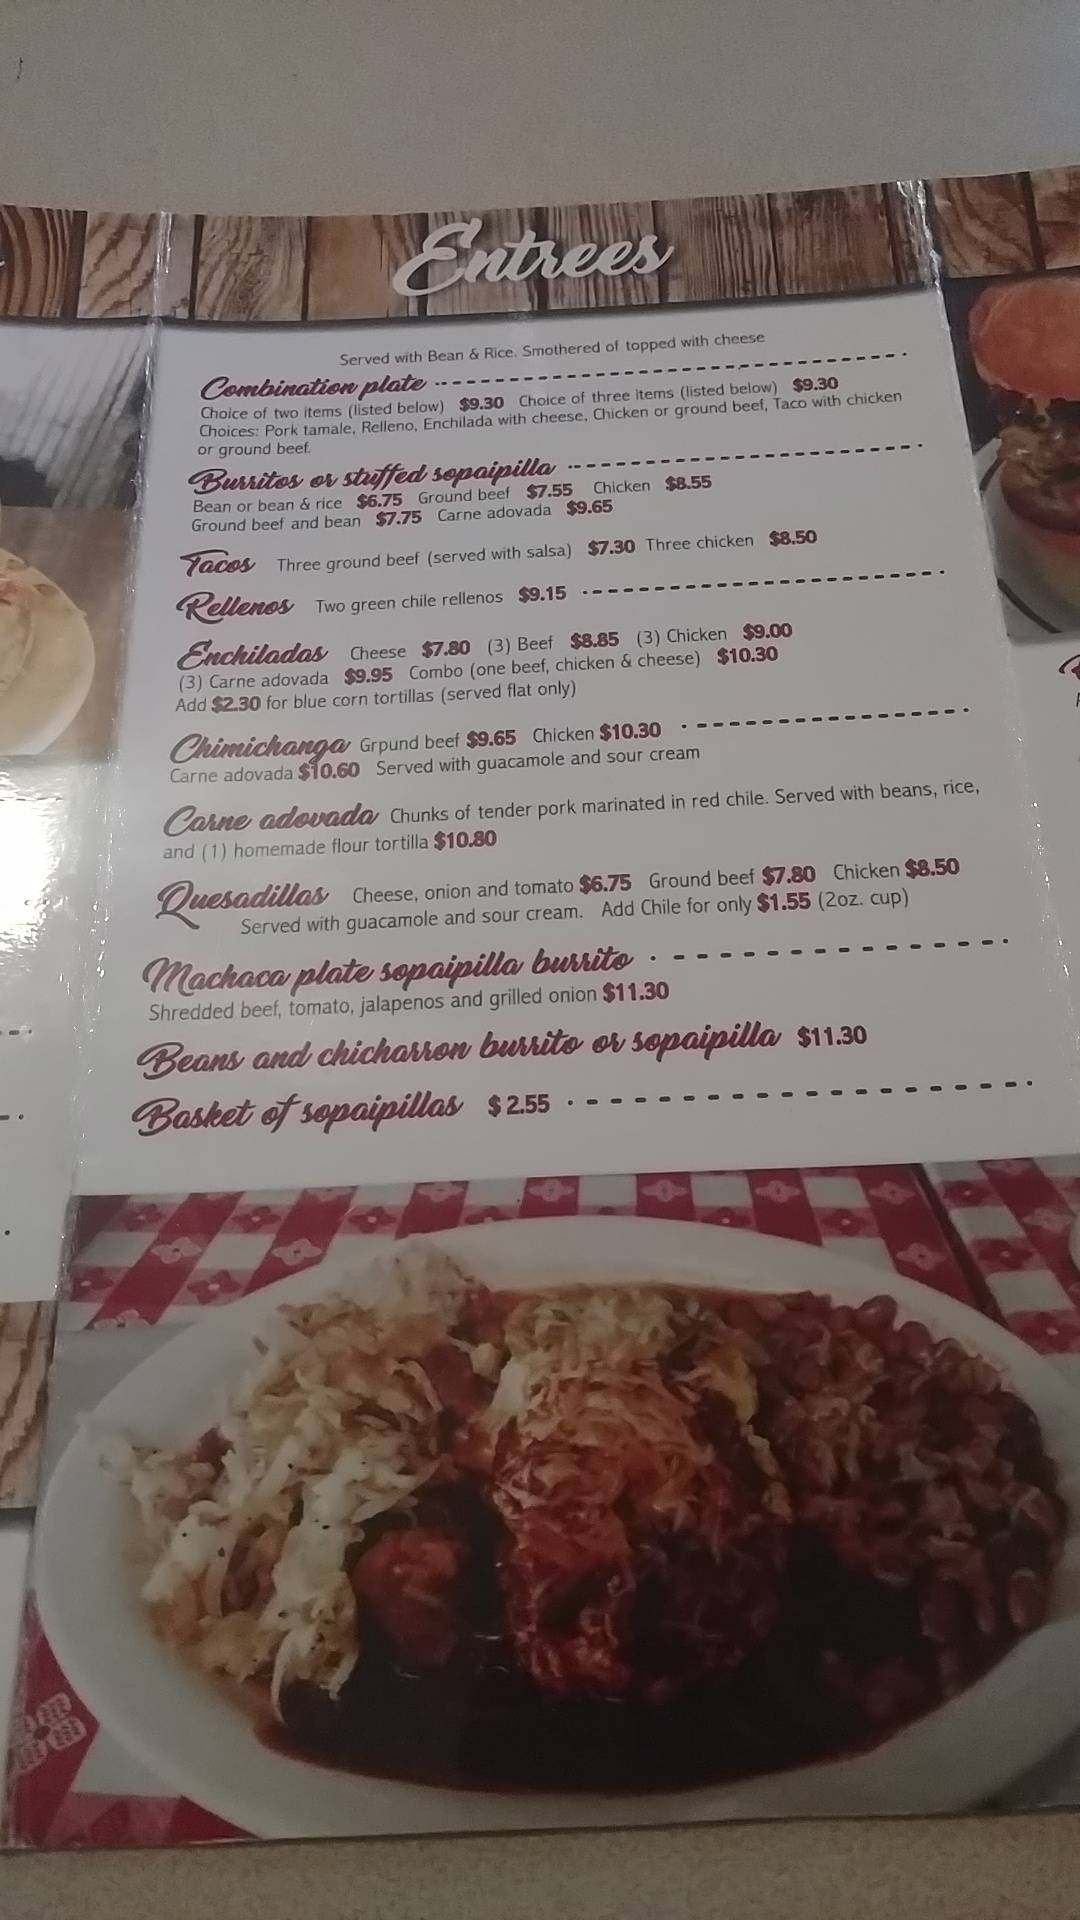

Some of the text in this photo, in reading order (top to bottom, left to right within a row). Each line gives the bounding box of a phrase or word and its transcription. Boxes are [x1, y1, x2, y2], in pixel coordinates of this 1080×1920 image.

[392, 217, 674, 297] Entrees
[339, 333, 765, 367] Served with Bean & Rice. Smothered of topped with cheese
[200, 374, 427, 401] Combination plate
[201, 376, 838, 420] Choice of two items (listed below) $9.30 Choice of three items (listed below) $9.30
[198, 440, 310, 460] or ground beef.
[188, 457, 557, 495] Burritos or stuffed sopaipilla
[193, 474, 712, 513] Bean or bean & rice $6.75 Ground beef $7.55 Chicken $8.55
[180, 529, 817, 577] Tacos Three ground beef (served with salsa) $7.30 Three chicken $8.50
[176, 585, 566, 624] Rellenos Two green chile rellenos $9.15
[177, 623, 792, 671] Enchiladas Cheese $7.80 (3) Beef $8.85 (3) Chicken $9.00
[180, 646, 778, 693] (3) Carne adovada $9.95 Combo (one beef, chicken & cheese) $10.30
[170, 733, 351, 764] Chimichanga
[425, 731, 460, 750] beef
[466, 730, 516, 749] $9.65
[533, 725, 594, 744] Chicken
[600, 722, 661, 742] $10.30
[163, 778, 979, 837] Carne adovada Chunks of tender pork marinated in red chile. Served with beans, rice,
[155, 858, 960, 930] Quesadillas Cheese, onion and tomato $6.75 Ground beef $7.80 Chicken $8.50
[241, 888, 908, 934] Served with guacamole and sour cream. Add Chile for only $1.55 (2oz. cup)
[142, 946, 634, 997] Machaca plate sopaipilla burrito
[149, 981, 669, 1022] Shredded beef, tomato, jalapenos and grilled onion $11.30
[137, 1021, 867, 1080] Beans and chicharron burrito or sopaipilla $11.30
[132, 1098, 256, 1137] Basket
[261, 1092, 301, 1134] of
[300, 1090, 464, 1134] sopaipillas
